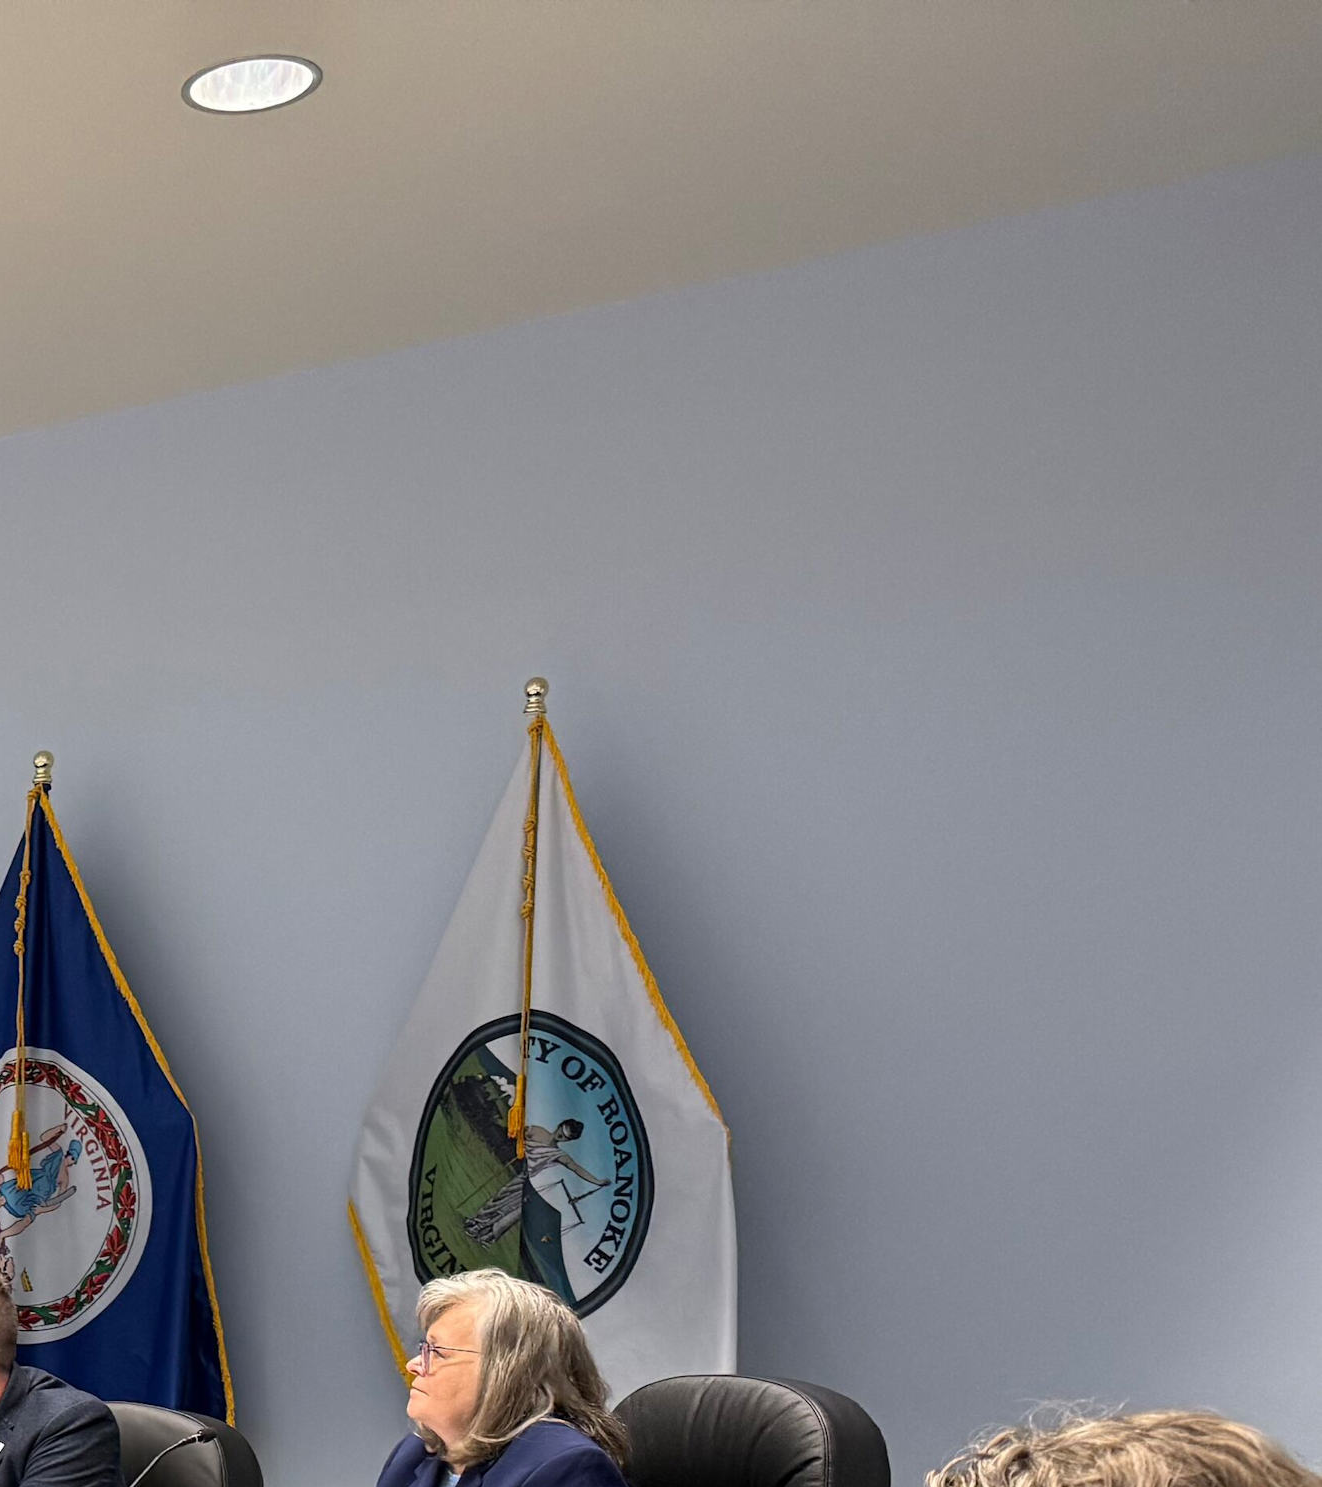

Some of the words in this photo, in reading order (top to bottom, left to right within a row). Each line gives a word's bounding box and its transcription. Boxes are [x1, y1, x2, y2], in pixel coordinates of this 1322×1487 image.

[523, 1036, 561, 1064] TY
[561, 1056, 607, 1092] OF
[63, 1103, 112, 1211] VIRGINIA
[583, 1093, 635, 1274] ROANOKE
[419, 1163, 469, 1278] VIRGIN
